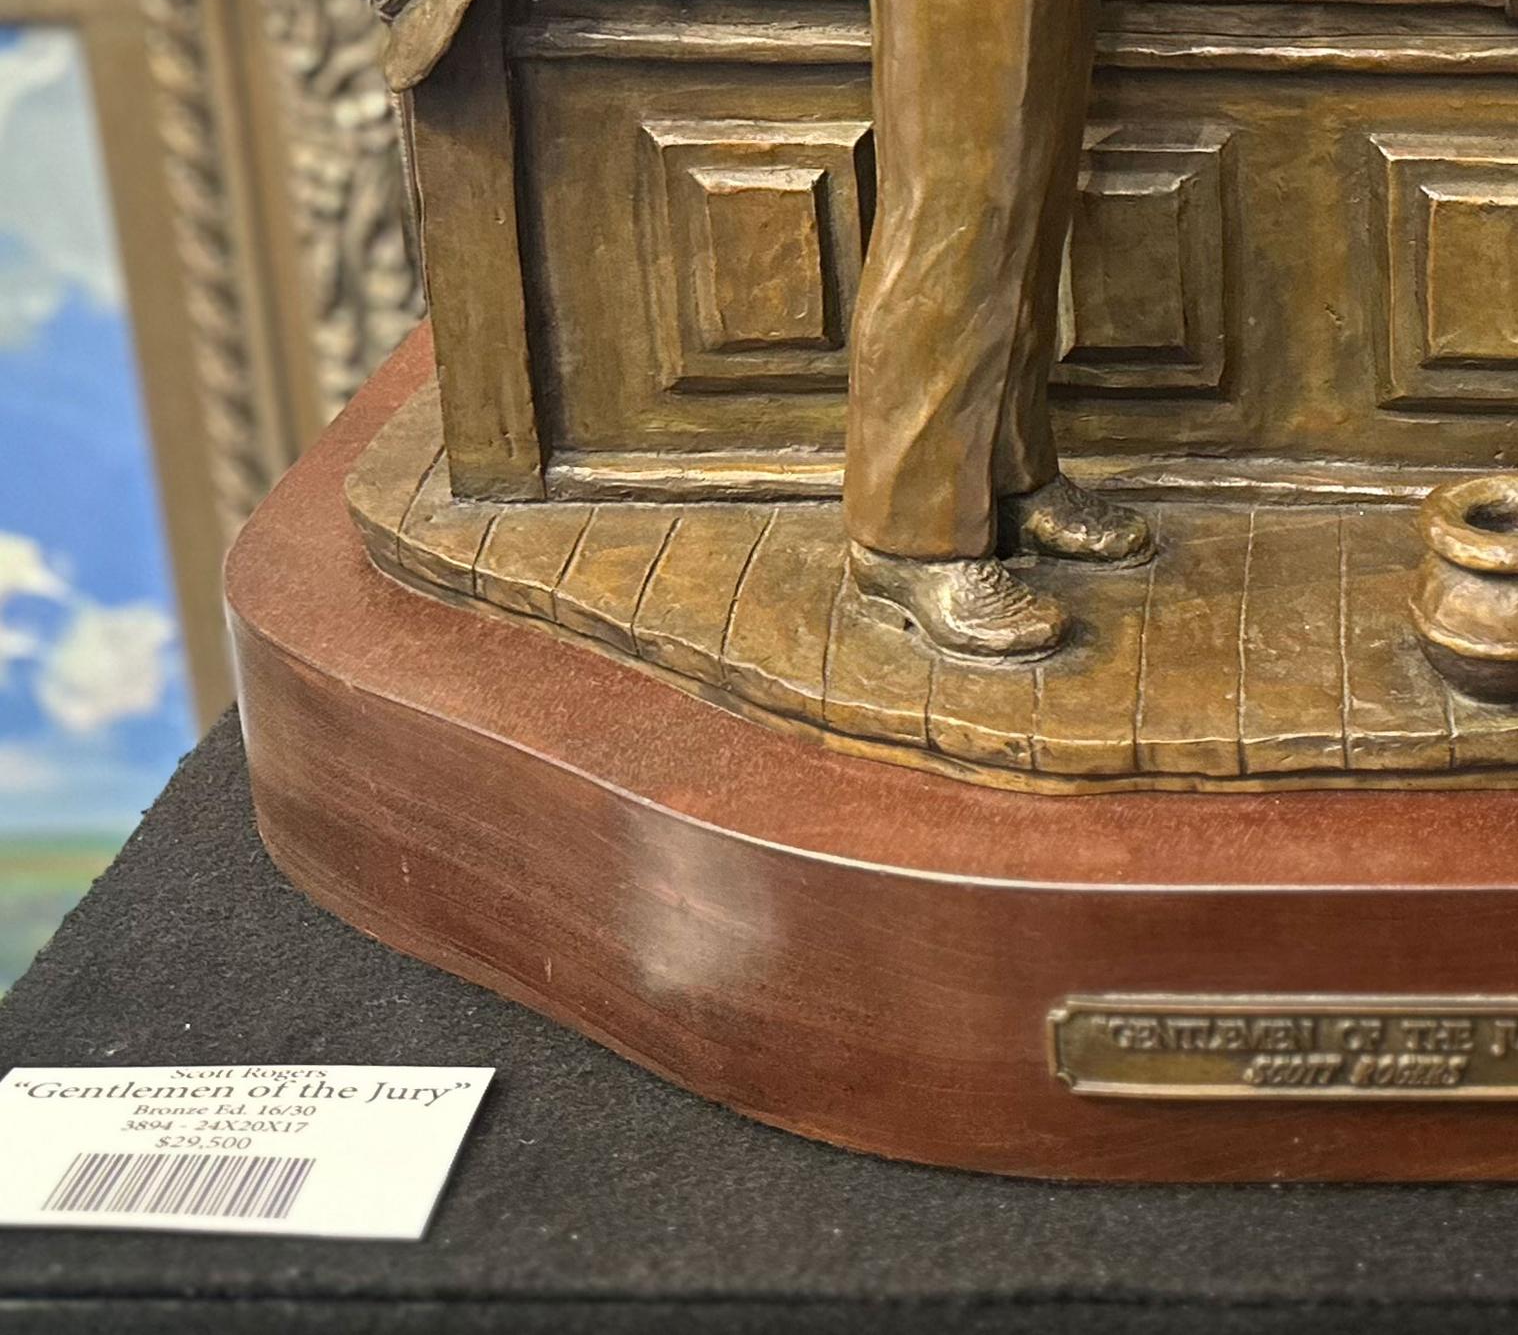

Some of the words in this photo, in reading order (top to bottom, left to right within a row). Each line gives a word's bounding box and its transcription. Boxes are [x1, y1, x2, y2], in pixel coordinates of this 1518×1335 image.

[1337, 1018, 1382, 1051] OF
[1400, 1018, 1474, 1050] THE
[170, 1068, 233, 1079] Scott
[242, 1067, 328, 1082] Rogers
[247, 1080, 297, 1098] of
[299, 1081, 358, 1099] the
[133, 1104, 209, 1115] Bronze
[213, 1104, 248, 1115] Ed.
[258, 1105, 317, 1116] 16/30
[121, 1120, 174, 1131] 3894
[155, 1135, 252, 1150] $29,500
